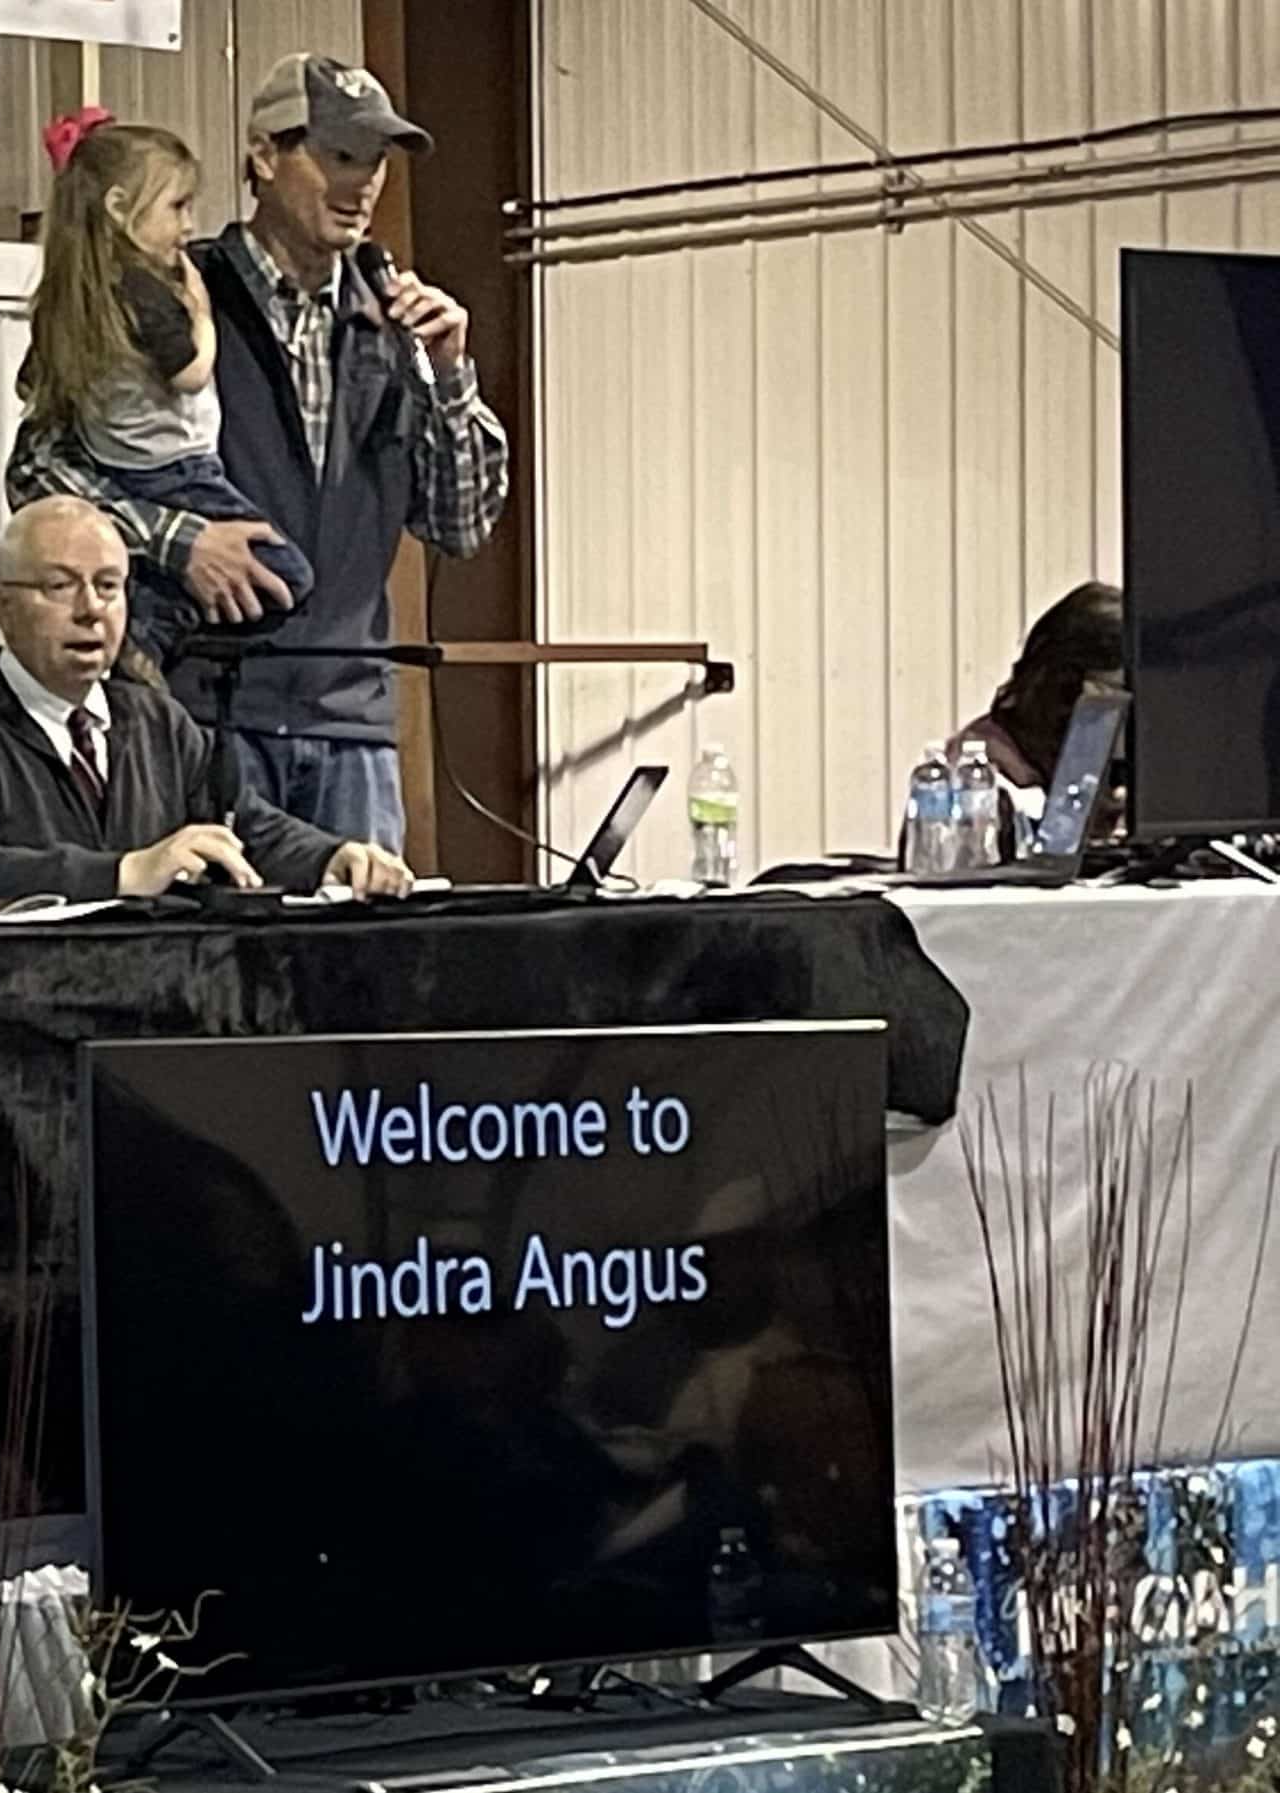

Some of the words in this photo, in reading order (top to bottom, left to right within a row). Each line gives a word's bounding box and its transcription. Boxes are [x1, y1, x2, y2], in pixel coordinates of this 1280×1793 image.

[311, 1082, 607, 1166] Welcome
[626, 1086, 689, 1155] to
[301, 1236, 492, 1323] Jindra
[514, 1234, 707, 1328] Angus
